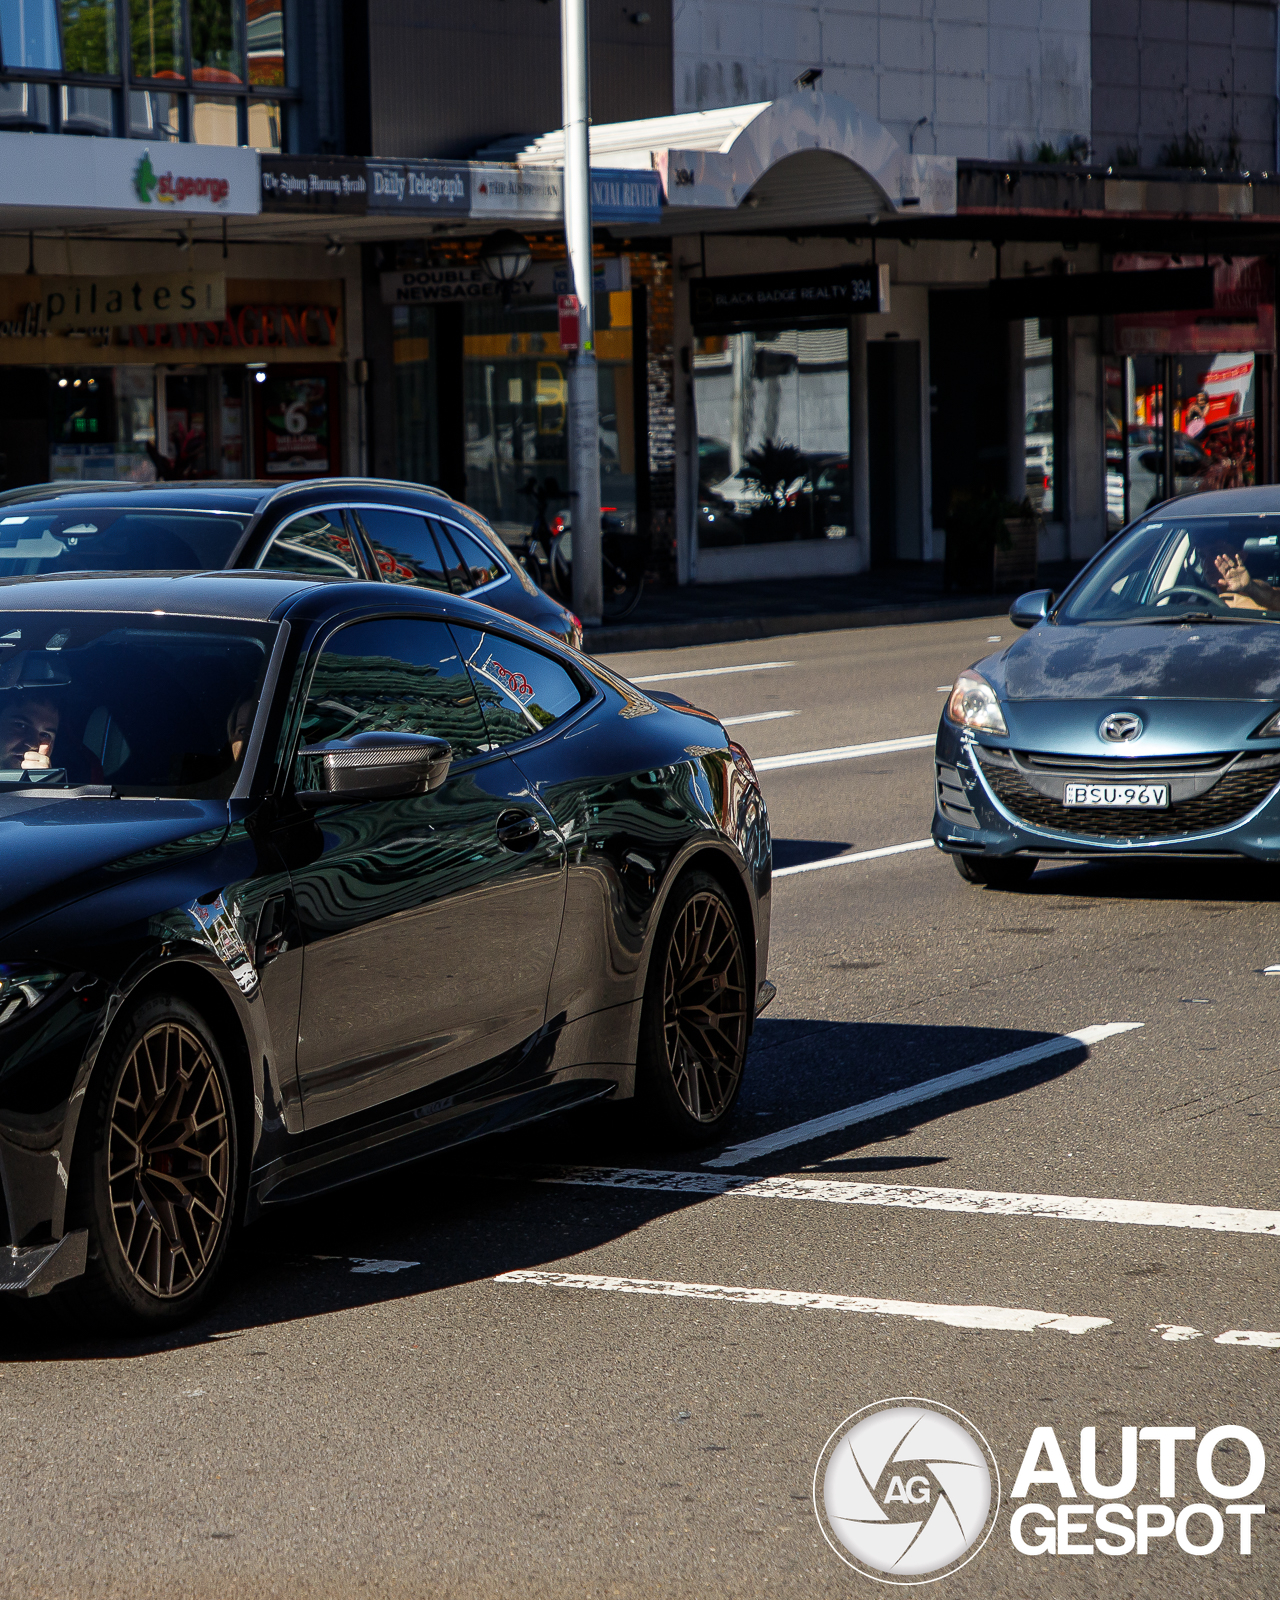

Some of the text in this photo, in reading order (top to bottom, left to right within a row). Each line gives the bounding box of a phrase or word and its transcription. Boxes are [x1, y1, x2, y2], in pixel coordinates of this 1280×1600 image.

[158, 171, 230, 203] st.george
[373, 171, 465, 203] Daily Telegraph
[402, 269, 482, 286] DOUBLE
[714, 293, 755, 307] BLACK
[757, 287, 798, 305] BADGE
[800, 284, 848, 301] REALTY
[850, 278, 872, 302] 394
[47, 281, 197, 323] pilates
